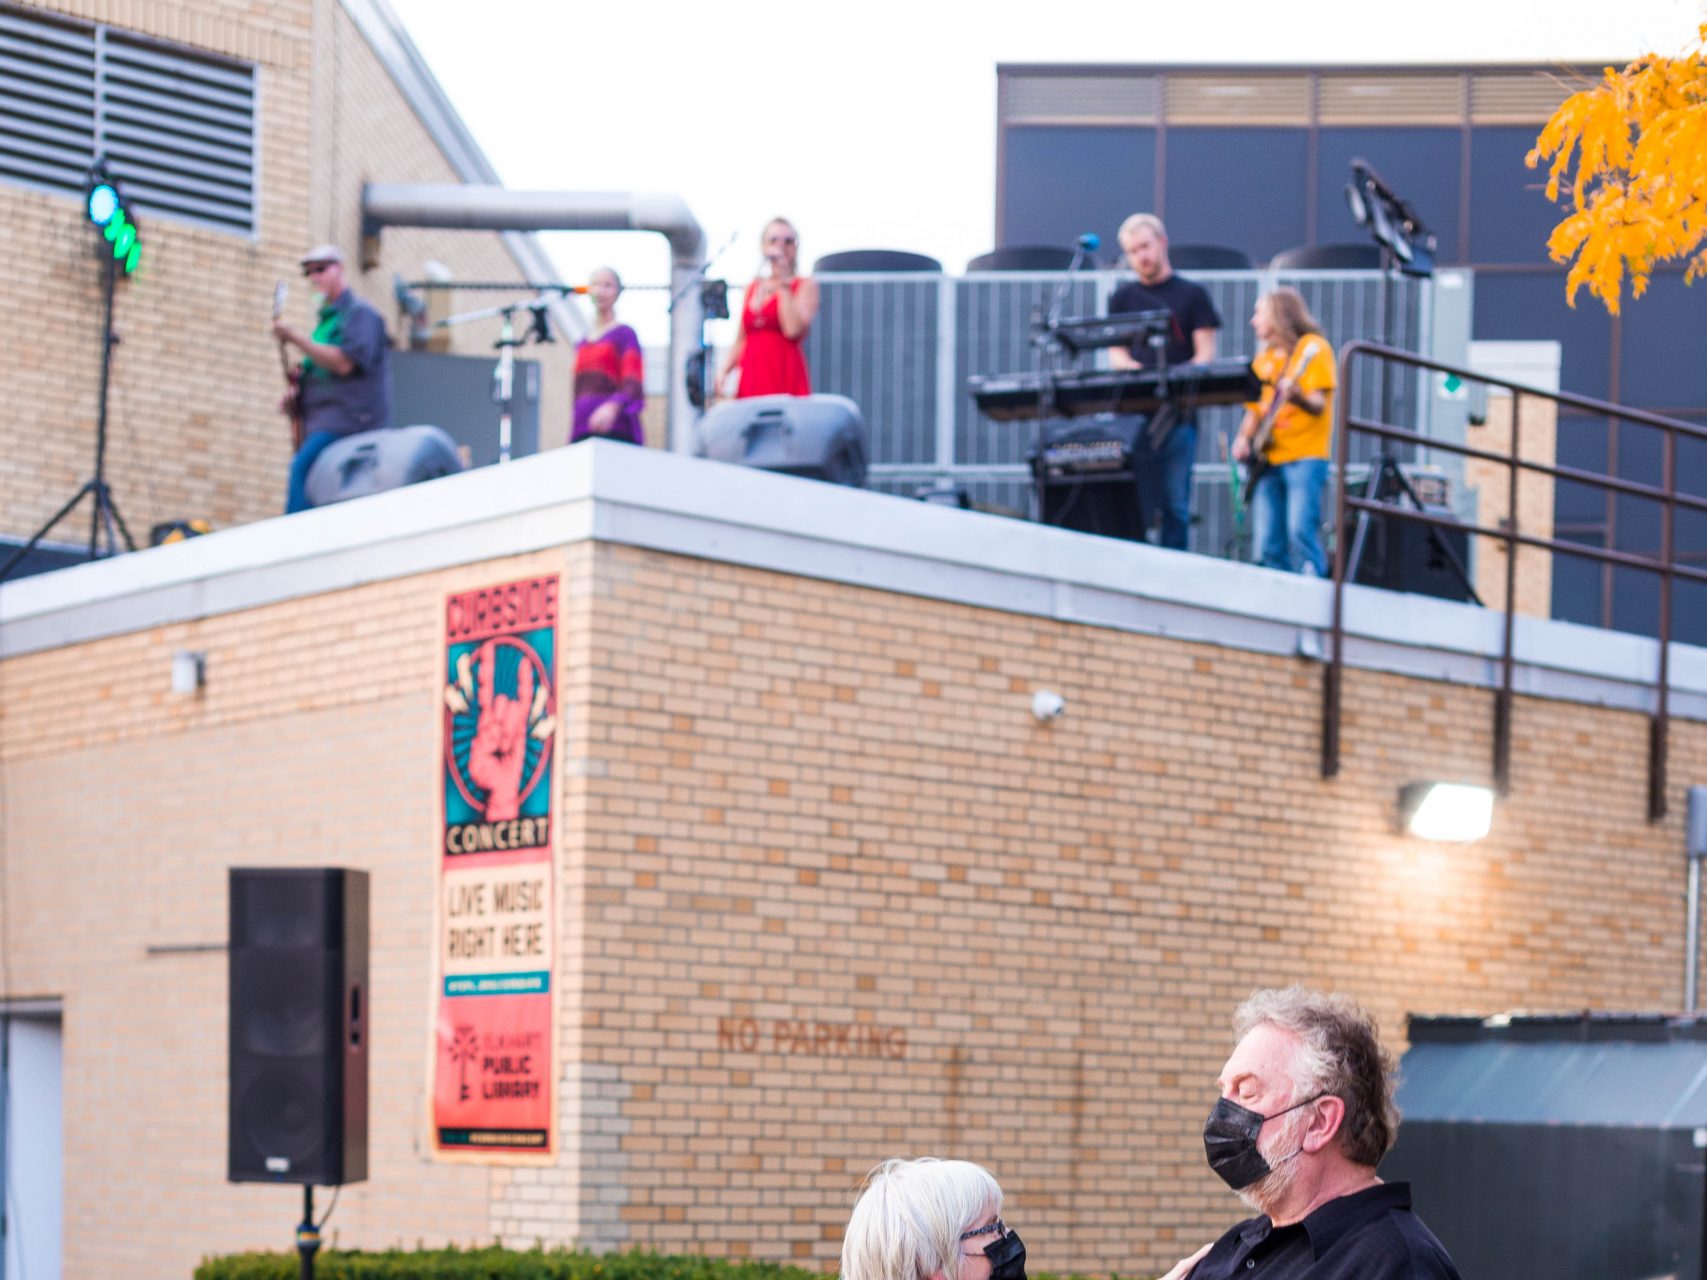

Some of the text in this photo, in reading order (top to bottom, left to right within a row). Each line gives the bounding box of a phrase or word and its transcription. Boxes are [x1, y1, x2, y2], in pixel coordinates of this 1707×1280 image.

[447, 816, 548, 854] CONCERT
[449, 879, 544, 918] LIVE MUSIC
[449, 922, 544, 960] RIGHT HERE
[717, 1015, 907, 1061] NO PARKING
[483, 1055, 531, 1075] PUBLIC
[483, 1080, 541, 1100] LIBRARY
